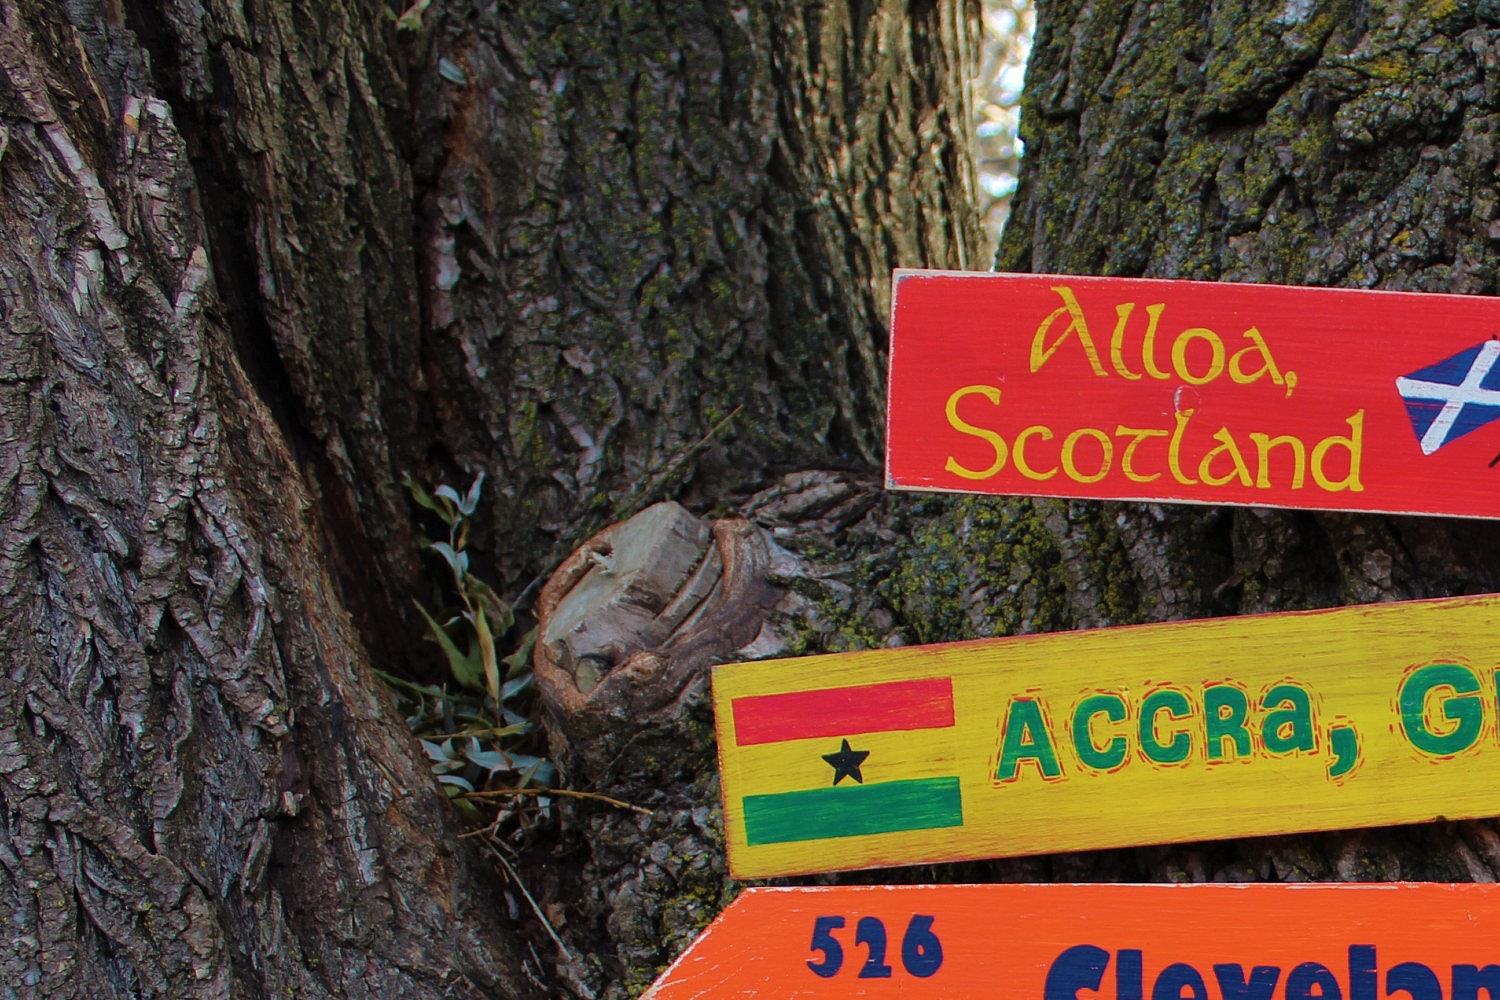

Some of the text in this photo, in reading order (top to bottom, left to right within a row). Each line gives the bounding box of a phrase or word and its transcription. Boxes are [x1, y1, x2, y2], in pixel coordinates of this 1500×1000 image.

[1029, 286, 1298, 399] Alloa,
[944, 384, 1365, 493] Scotland
[805, 914, 944, 979] 526
